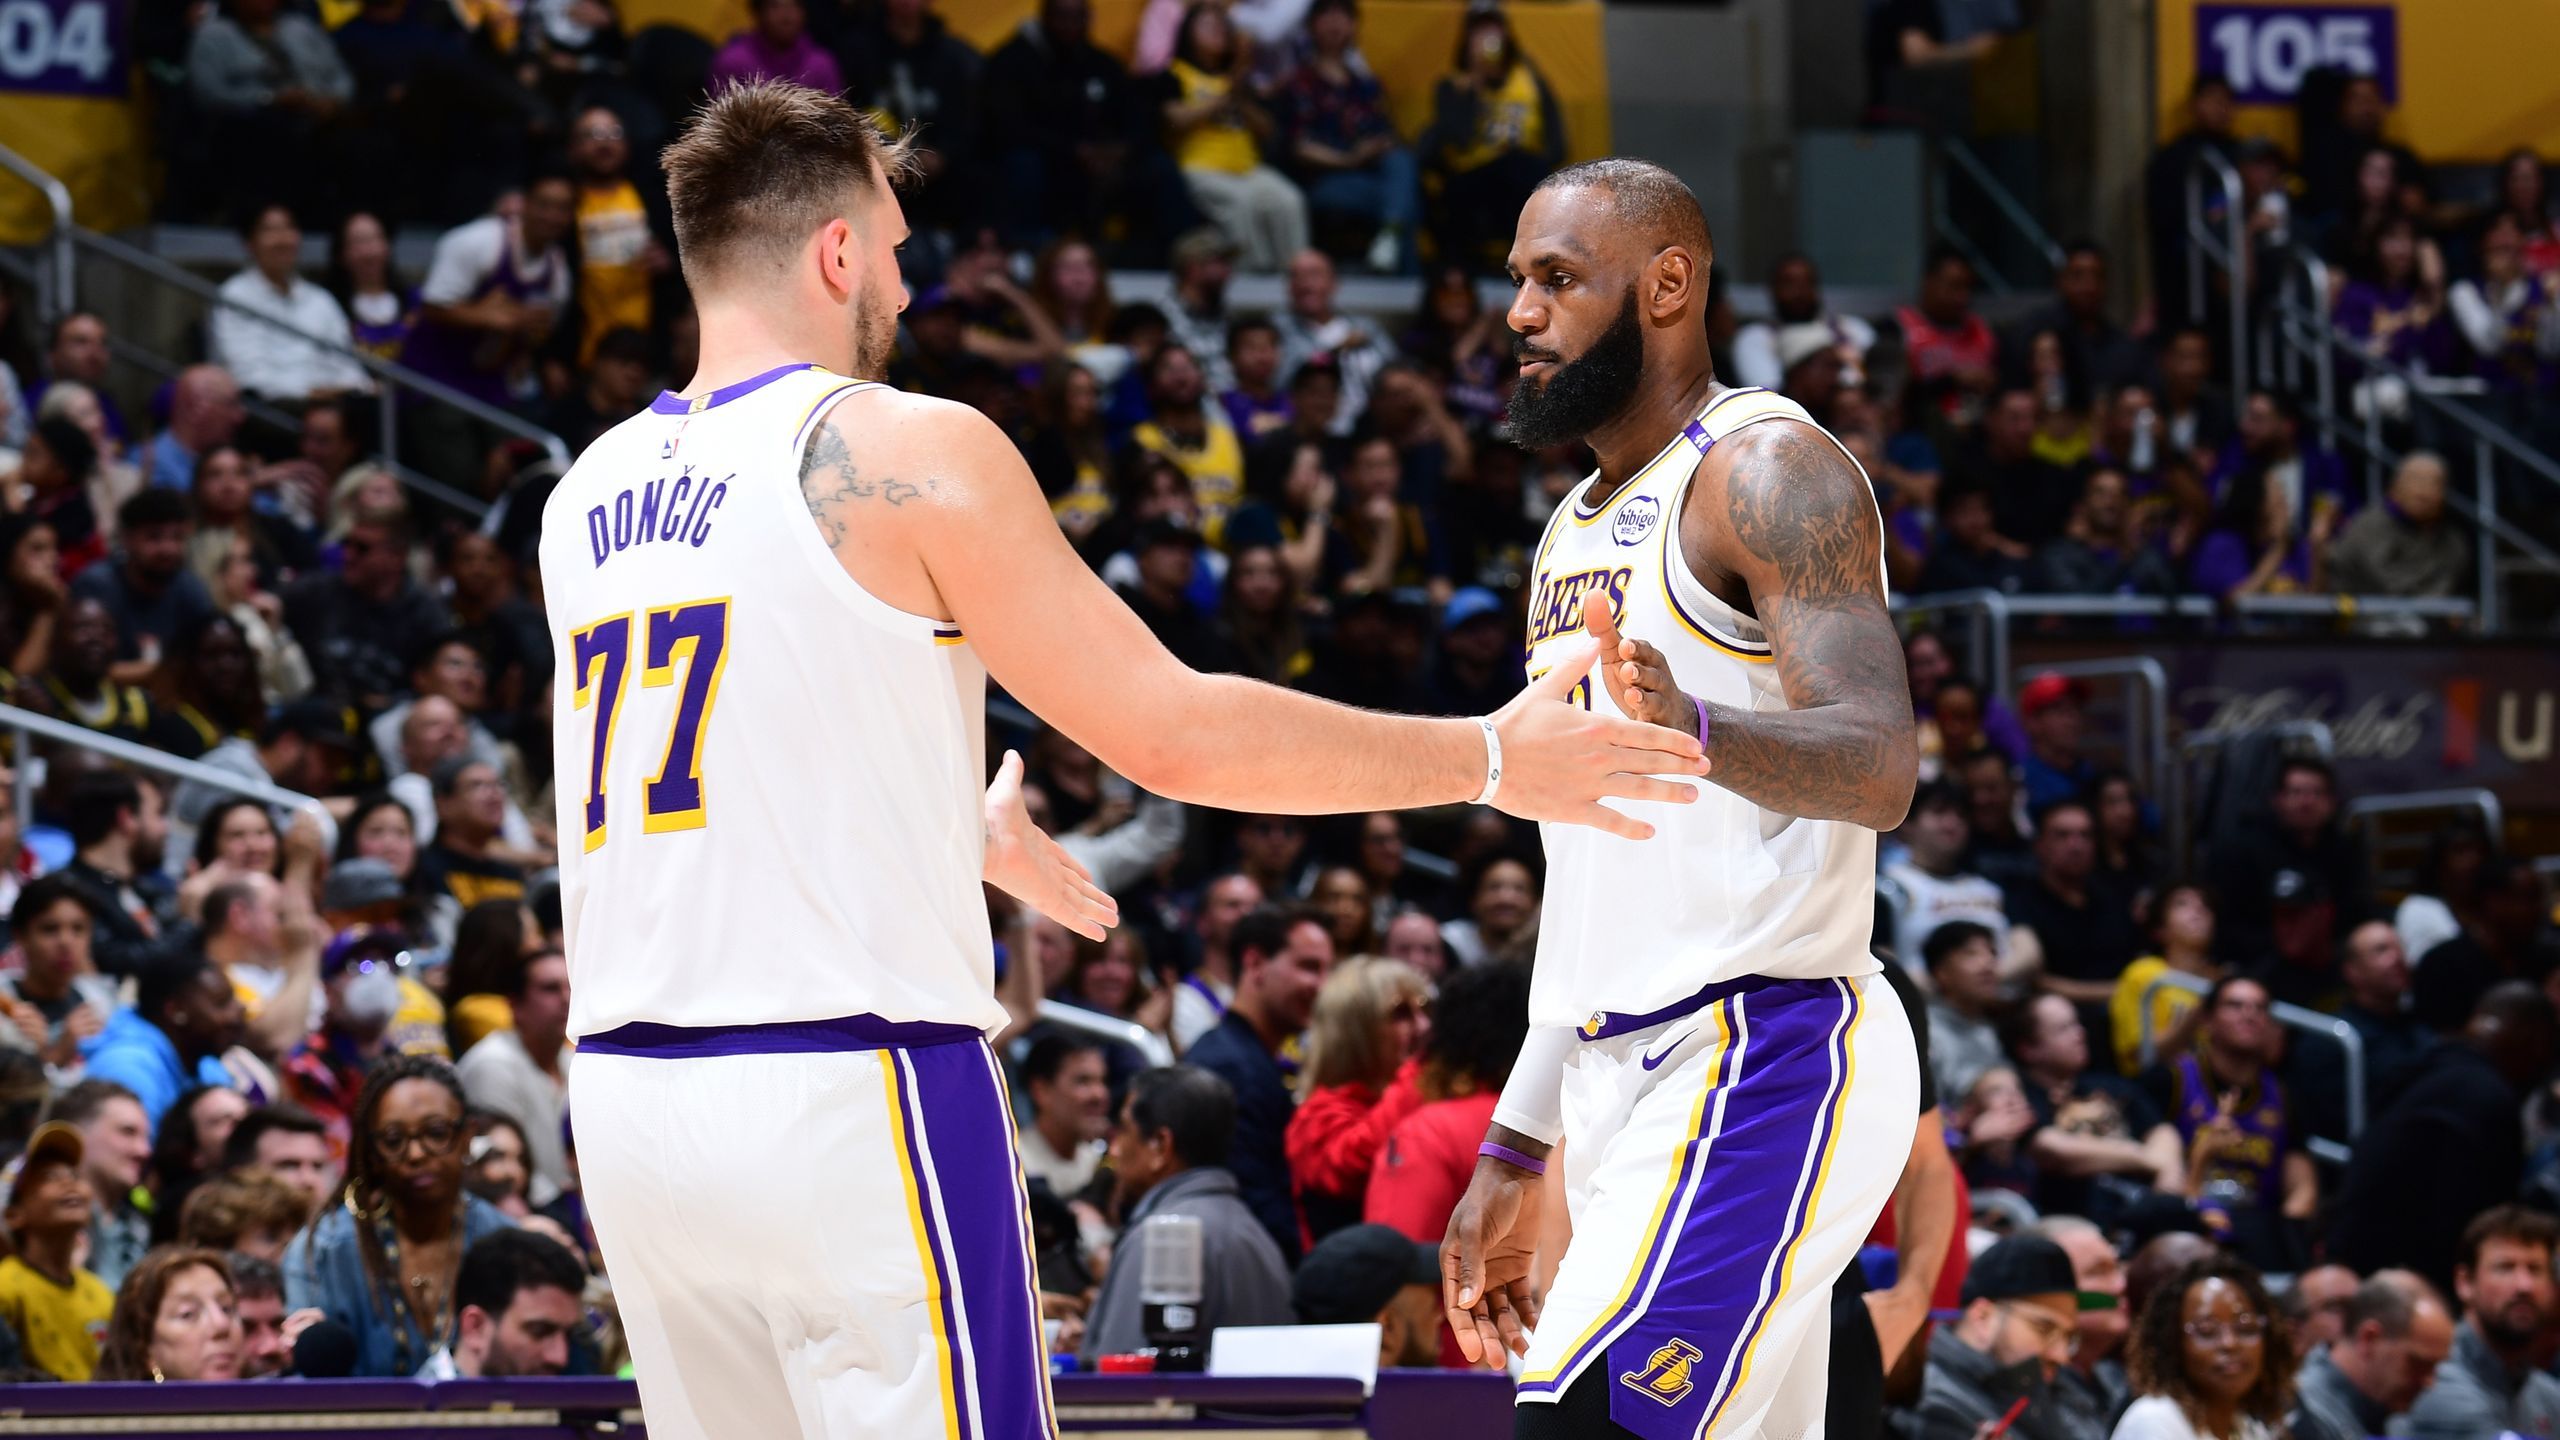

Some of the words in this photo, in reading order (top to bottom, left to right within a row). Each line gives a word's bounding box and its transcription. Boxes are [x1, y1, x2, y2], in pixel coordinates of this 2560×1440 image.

[2210, 14, 2378, 94] 105
[587, 464, 737, 570] DONČIĆ
[1617, 508, 1656, 531] bibigo
[569, 595, 733, 855] 77
